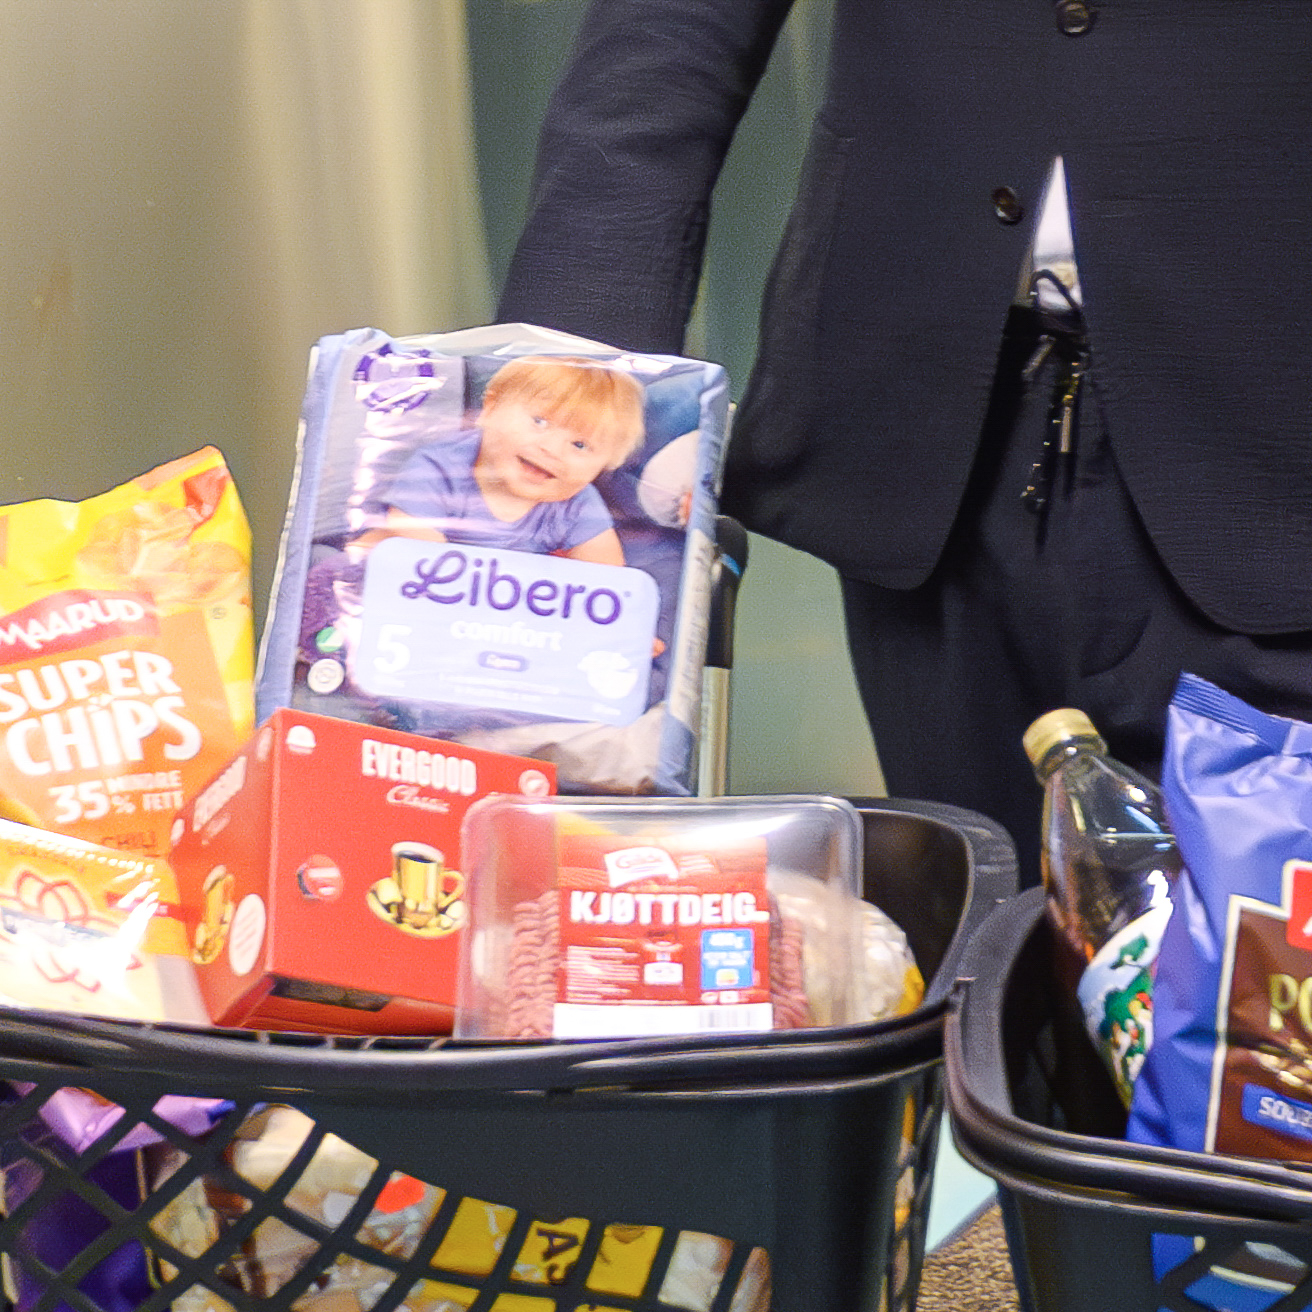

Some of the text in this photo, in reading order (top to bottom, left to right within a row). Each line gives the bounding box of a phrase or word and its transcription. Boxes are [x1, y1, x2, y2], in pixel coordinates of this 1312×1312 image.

[401, 549, 622, 626] Libero
[373, 624, 414, 674] 5
[450, 620, 564, 652] comfort
[361, 738, 477, 796] EVERGOOD
[48, 779, 110, 825] 35
[111, 794, 137, 815] %
[570, 891, 760, 926] KJØTTDEIG
